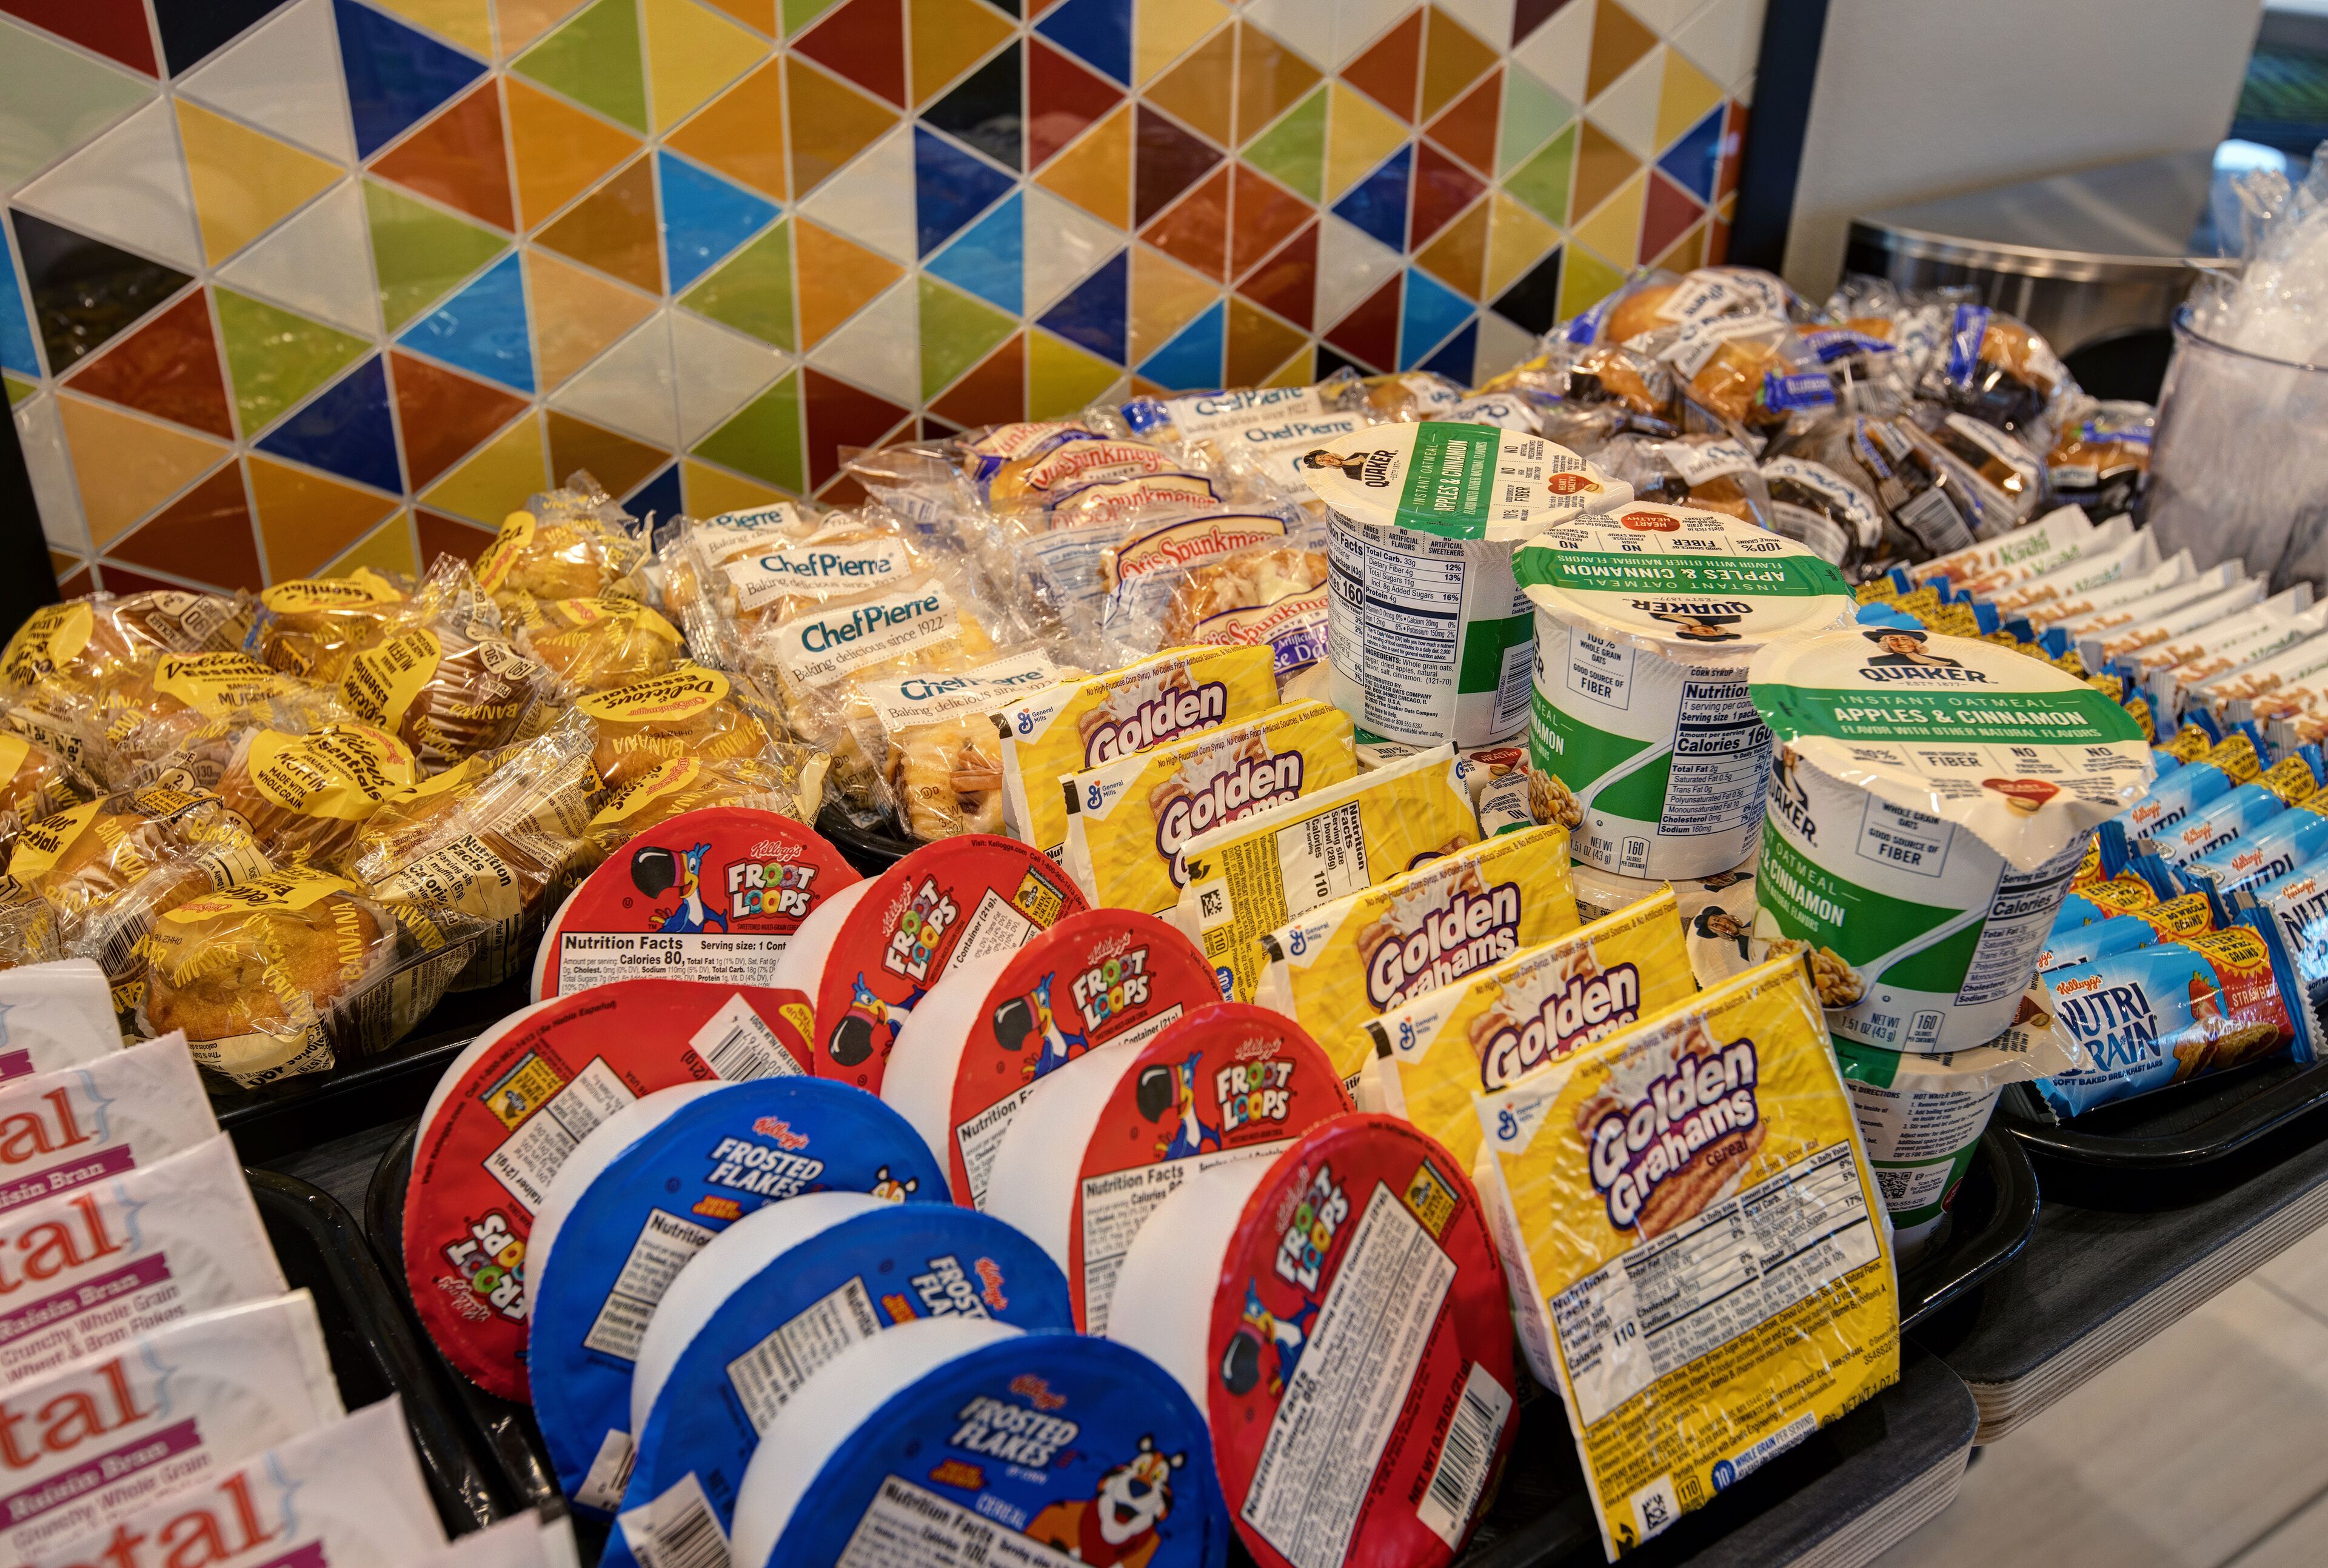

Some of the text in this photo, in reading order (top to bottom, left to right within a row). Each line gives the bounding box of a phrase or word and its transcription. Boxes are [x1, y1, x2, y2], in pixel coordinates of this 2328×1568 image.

[1365, 450, 1397, 488] QUAKER
[1442, 439, 1469, 478] CINNAMON
[1413, 444, 1438, 504] INSTANT OATMEAL
[1558, 478, 1567, 491] HEART
[1568, 476, 1576, 493] HEALTHY
[1434, 485, 1459, 512] APPLES
[1514, 486, 1530, 502] FIBER
[1362, 529, 1380, 542] COLORS
[1389, 533, 1419, 545] ARTIFICIAL
[1392, 541, 1416, 551] FLAVORS
[1431, 541, 1463, 550] ARTIFICIAL
[1366, 546, 1382, 559] Total
[1383, 553, 1402, 563] Carb.
[1404, 558, 1416, 567] 33g
[1562, 564, 1680, 579] CINNAMON
[1587, 578, 1777, 591] INSTANT OATMEAL
[1703, 570, 1786, 582] APPLES
[1343, 581, 1363, 605] 160
[1365, 586, 1388, 599] Protein
[1632, 599, 1754, 615] QUAKER
[792, 658, 836, 682] Baking
[836, 641, 886, 664] delicious
[888, 629, 917, 647] since
[1365, 647, 1401, 664] INGREDIENTS:
[1403, 658, 1421, 669] Whole
[1423, 662, 1437, 672] grain
[591, 675, 699, 704] Essentials
[1086, 671, 1151, 696] No High Fructose Corn Syrup,
[1426, 678, 1452, 687] (121-70)
[1581, 677, 1611, 698] FIBER
[1859, 667, 1990, 684] QUAKER
[604, 681, 715, 709] Delicious
[1839, 695, 2054, 709] INSTANT OATMEAL
[1032, 707, 1054, 718] General
[1034, 715, 1047, 724] Mills
[1835, 708, 2090, 726] APPLES & CINNAMON
[1089, 685, 1222, 769] Golden
[612, 734, 683, 758] BANANA
[1677, 738, 1740, 752] Calories
[2010, 748, 2036, 758] NO
[275, 753, 326, 792] MUFFIN
[1928, 757, 1982, 767] FIBER
[257, 770, 304, 810] WHOLE GRAIN
[269, 766, 307, 798] MADE WITH
[1160, 755, 1300, 855] Golden
[1311, 818, 1322, 859] Calories
[1331, 811, 1342, 845] Serving
[1340, 807, 1353, 850] Facts
[1349, 805, 1365, 871] Nutrition
[447, 842, 484, 872] Facts
[750, 840, 801, 862] Kellogg's
[988, 840, 1028, 856] Kelloggs.com
[1030, 852, 1042, 863] Call
[1323, 822, 1337, 870] bowl (28g)
[1590, 836, 1613, 852] NET WT
[1628, 841, 1644, 856] 160
[1879, 843, 1921, 866] FIBER
[430, 862, 456, 882] muffin
[460, 834, 512, 887] Nutrition
[1776, 843, 1838, 896] OATMEAL
[728, 862, 816, 893] FROOT
[1314, 870, 1328, 898] 110
[732, 890, 812, 918] LOOPS
[1032, 889, 1049, 918] WHOLE
[1039, 893, 1053, 921] GRAIN
[1770, 859, 1846, 927] CINNAMON
[329, 902, 364, 981] BANANA
[884, 878, 940, 977] FROOT
[906, 895, 958, 984] LOOPS
[566, 936, 683, 950] Nutrition Facts
[701, 941, 756, 952] Serving size:
[1371, 886, 1516, 1004] Golden
[2230, 949, 2258, 962] GRAINS
[620, 954, 661, 966] Calories
[1071, 949, 1148, 1011] FROOT
[2056, 974, 2102, 995] Kellogg's
[1083, 975, 1150, 1033] LOOPS
[1487, 968, 1636, 1087] Golden
[1916, 1015, 1937, 1030] 160
[1216, 1061, 1293, 1104] FROOT
[2078, 1075, 2107, 1086] BAKED
[2109, 1065, 2146, 1081] BREAKFAST
[2147, 1059, 2163, 1070] BARS
[1222, 1090, 1289, 1132] LOOPS
[1593, 1043, 1754, 1188] Golden
[712, 1138, 824, 1182] FROSTED
[1610, 1089, 1756, 1226] Grahams
[1706, 1135, 1748, 1167] cereal
[47, 1162, 106, 1190] Bran
[709, 1162, 806, 1201] FLAKES
[1086, 1165, 1184, 1198] Nutrition Facts
[1277, 1166, 1333, 1284] FROOT
[75, 1304, 129, 1334] Whole
[134, 1284, 178, 1312] Grain
[1611, 1321, 1636, 1348] 110
[960, 1397, 1079, 1447] FROSTED
[951, 1421, 1060, 1468] FLAKES
